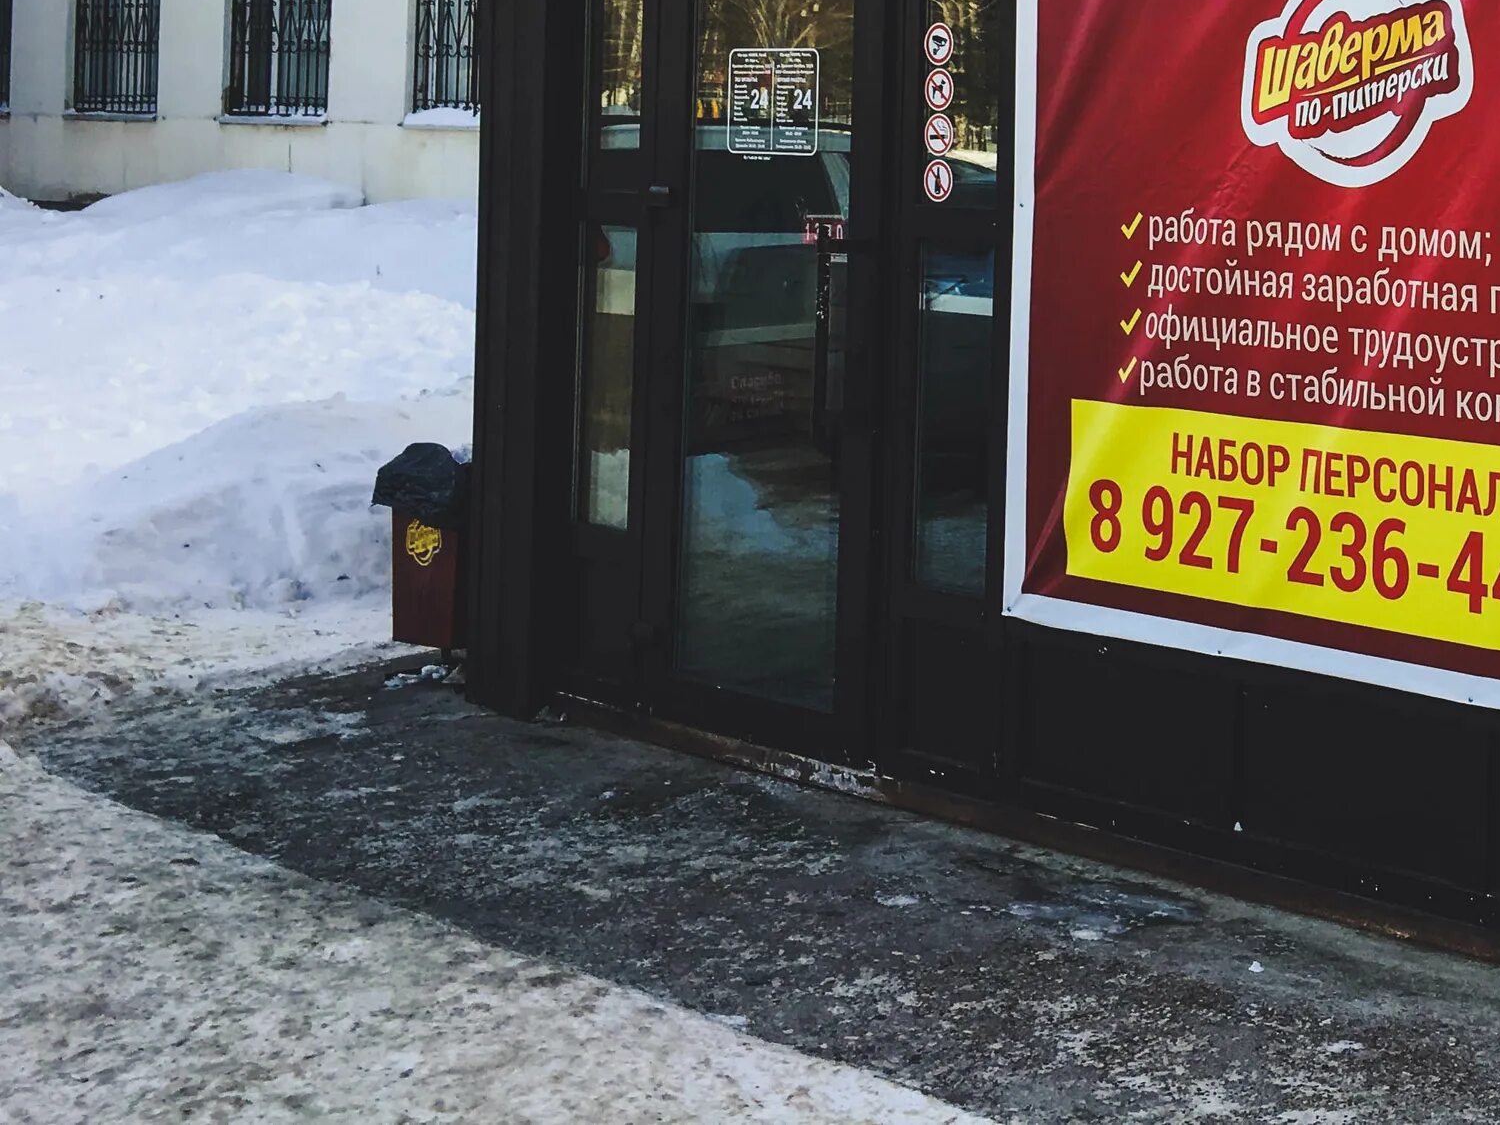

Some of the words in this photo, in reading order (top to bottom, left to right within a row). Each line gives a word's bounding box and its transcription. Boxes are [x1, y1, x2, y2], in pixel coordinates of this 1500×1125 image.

[1258, 10, 1446, 114] Шаверма
[1295, 53, 1449, 127] по-питерски
[793, 88, 813, 110] 24
[1149, 207, 1236, 250] работа
[1247, 220, 1341, 256] рядом
[1351, 228, 1368, 252] с
[1378, 225, 1493, 266] домом;
[1147, 259, 1293, 300] достойная
[1301, 268, 1478, 313] заработная
[1144, 305, 1339, 354] официальное
[1139, 356, 1238, 395] работа
[1247, 370, 1261, 396] в
[1269, 370, 1444, 418] стабильной
[1171, 432, 1290, 488] НАБОР
[1088, 478, 1123, 554] 8
